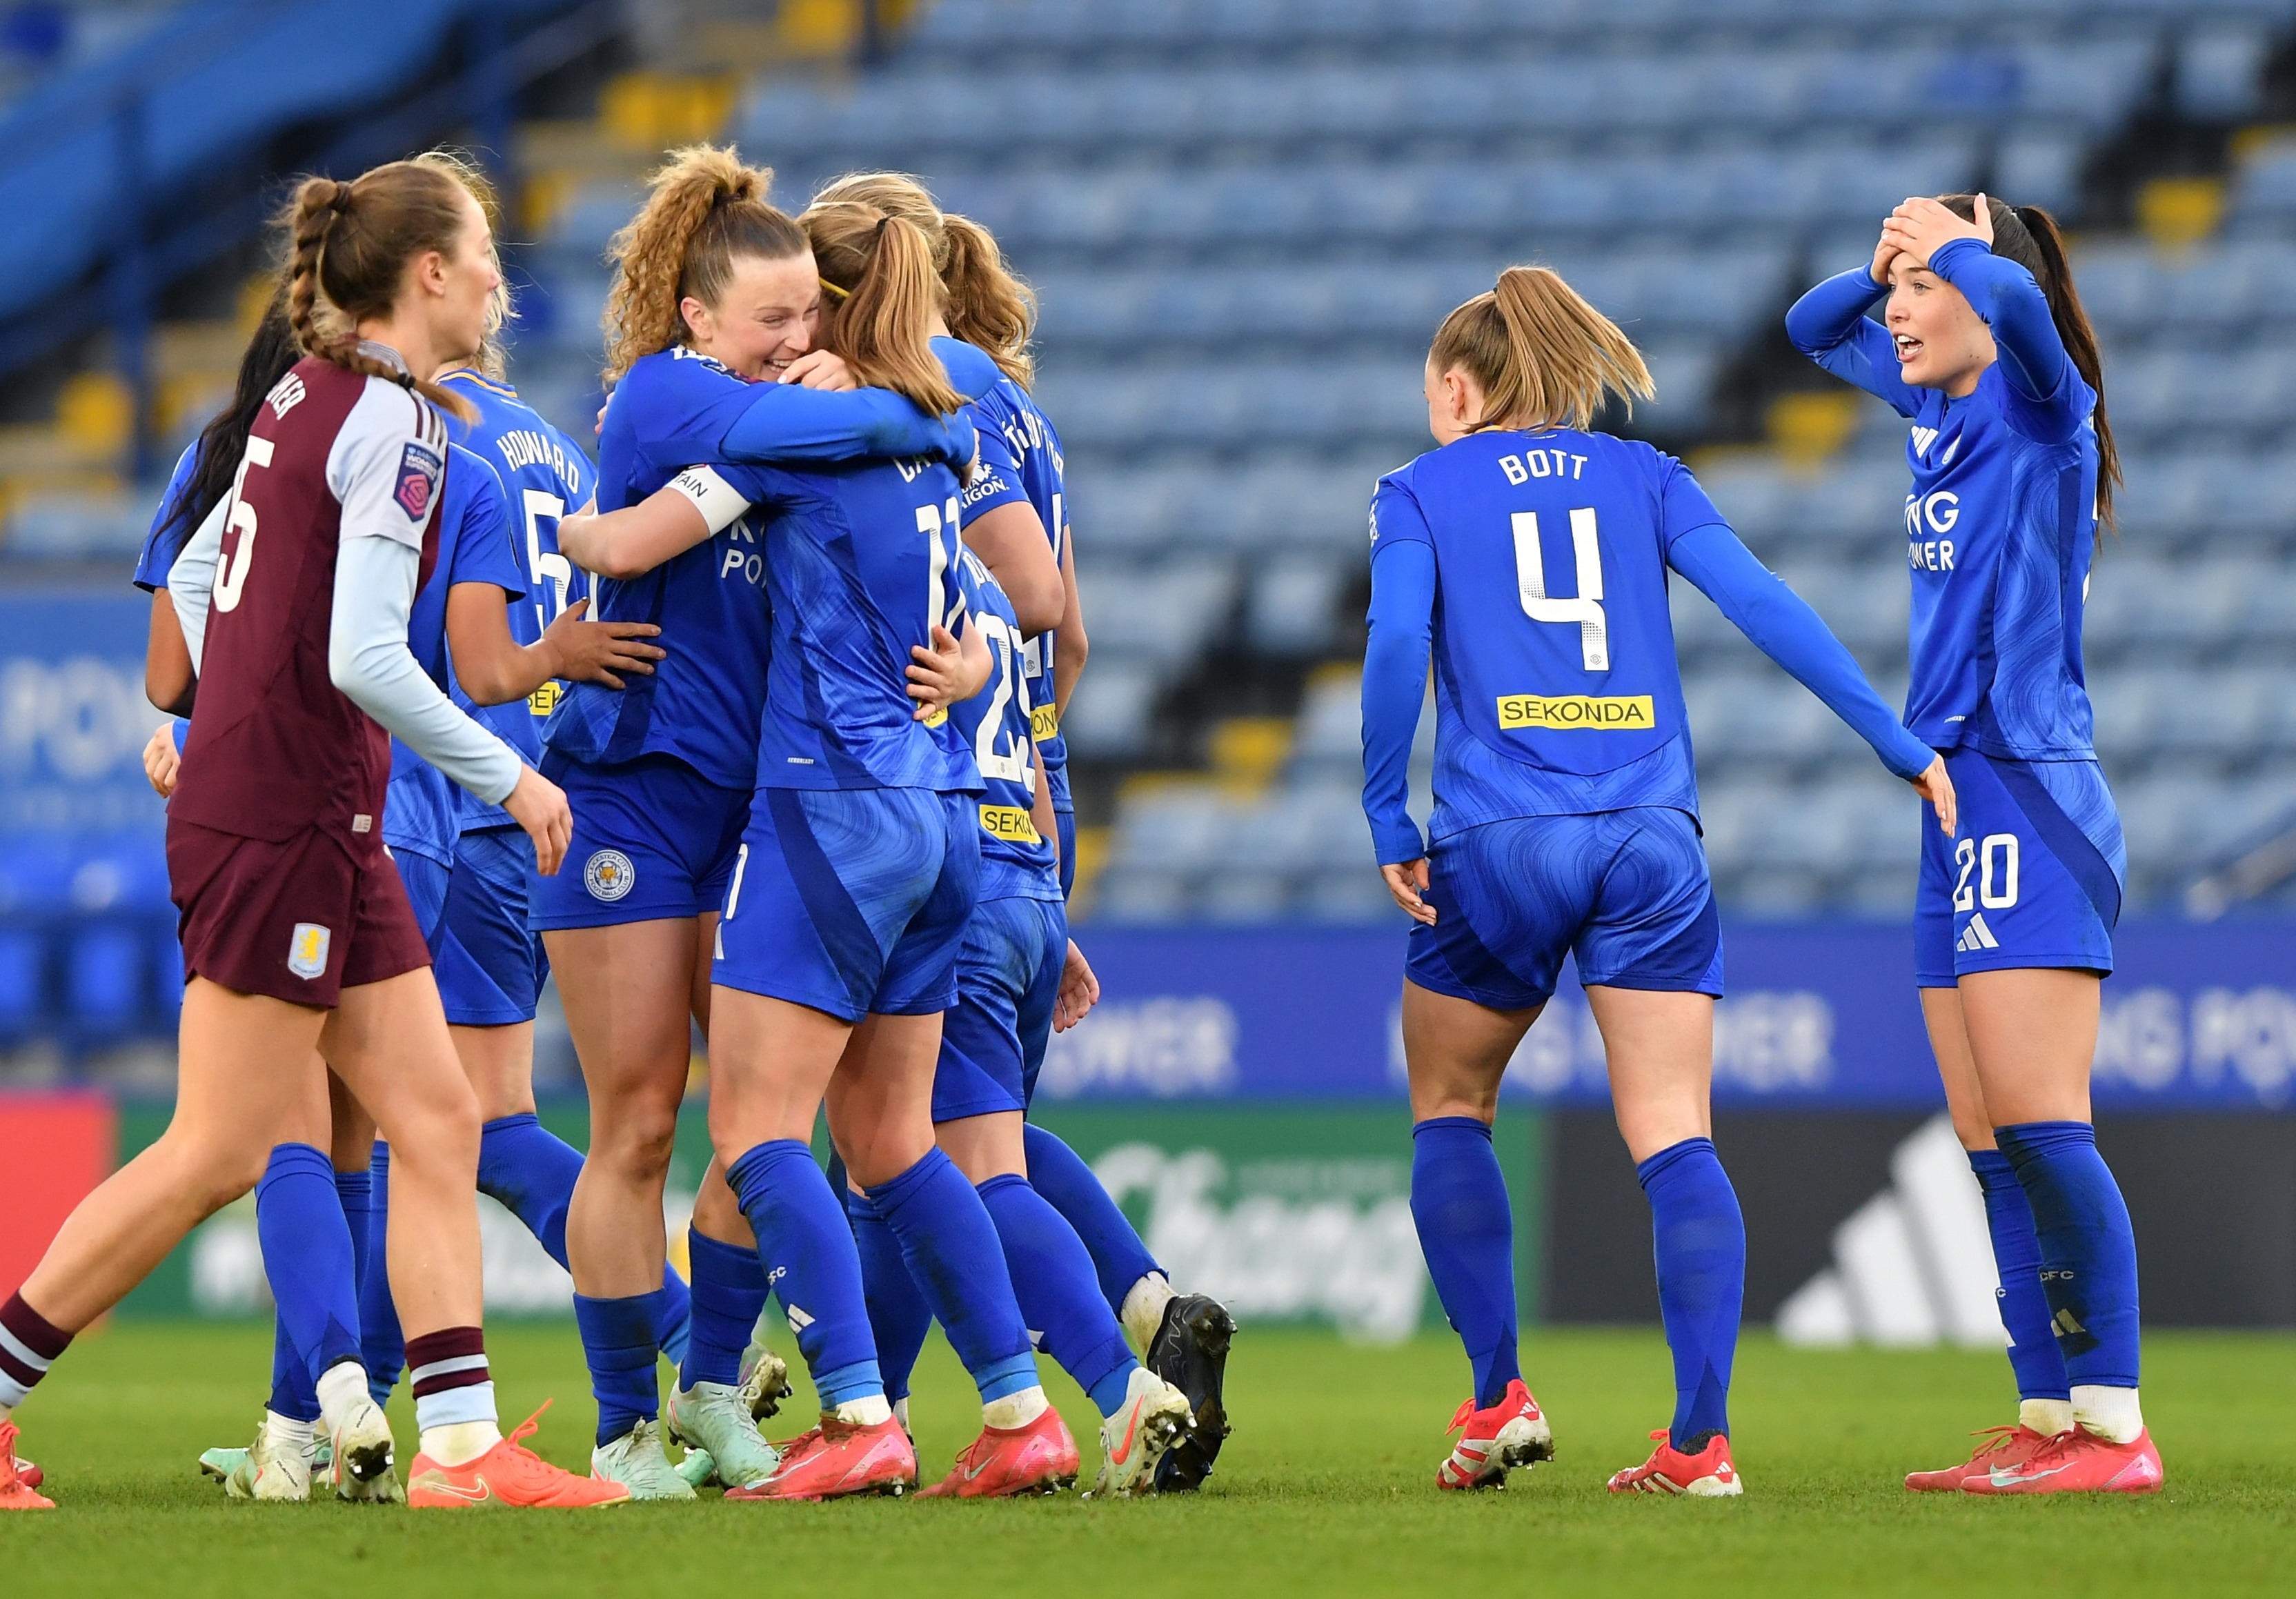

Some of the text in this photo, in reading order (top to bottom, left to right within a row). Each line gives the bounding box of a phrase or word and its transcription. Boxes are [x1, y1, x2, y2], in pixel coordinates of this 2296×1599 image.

[496, 430, 579, 494] HOWARD
[1498, 449, 1587, 486] BOTT
[523, 488, 572, 638] 5
[1510, 507, 1610, 671] 4
[1504, 701, 1645, 722] SEKONDA
[617, 858, 629, 872] CITY
[1952, 833, 2019, 910] 20
